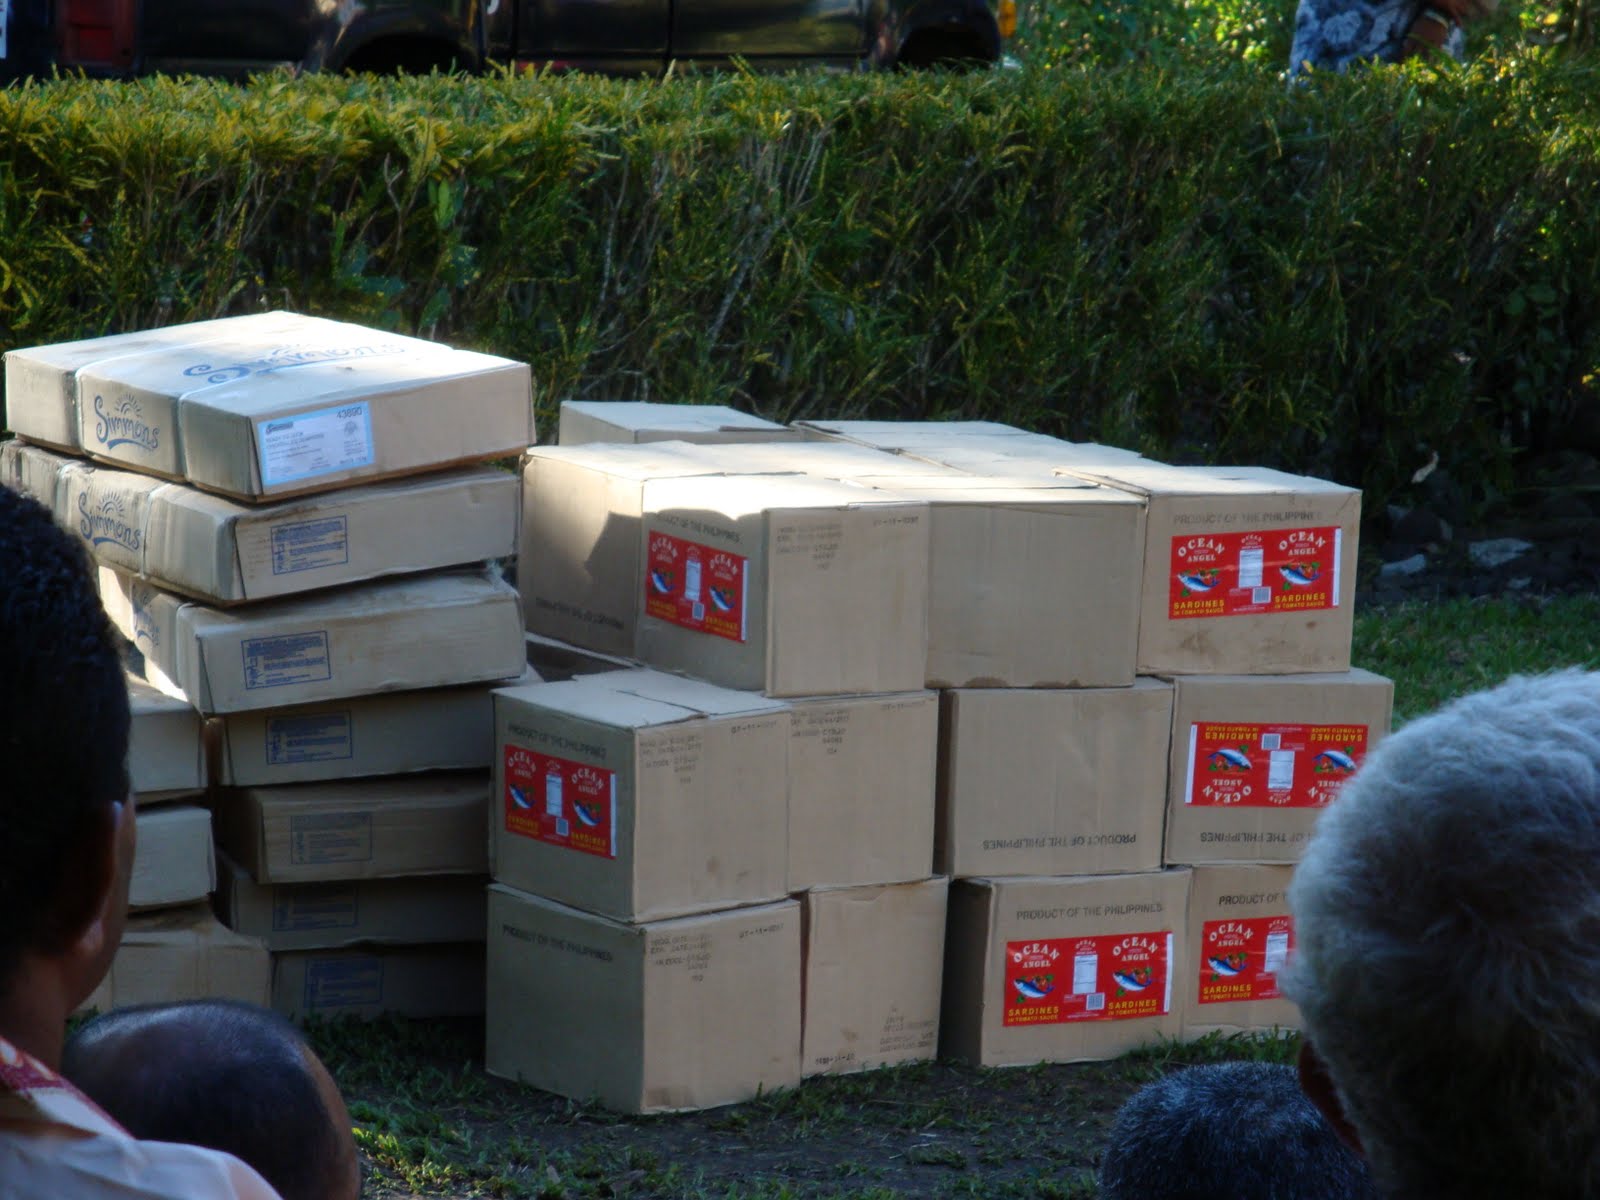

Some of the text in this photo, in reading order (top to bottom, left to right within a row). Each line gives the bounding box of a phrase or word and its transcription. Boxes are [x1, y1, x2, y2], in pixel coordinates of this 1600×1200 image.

[94, 395, 160, 449] Simmons
[78, 492, 142, 550] Simmons
[1174, 513, 1221, 525] PRODUCT
[1279, 531, 1326, 550] OCEAN
[1178, 538, 1225, 557] OCEAN
[1288, 547, 1317, 556] ANGEL
[1187, 554, 1217, 562] ANGEL
[1274, 592, 1326, 603] SARDINES
[1173, 599, 1225, 610] SARDINES
[1205, 731, 1258, 740] SARDINES
[1310, 733, 1362, 742] SARDINES
[571, 768, 604, 790] OCEAN
[1203, 786, 1252, 803] OCEAN
[1308, 787, 1338, 804] EAN
[1088, 833, 1137, 845] PRODUCT
[1200, 832, 1265, 843] PHILIPPINES
[1266, 832, 1286, 843] THE
[983, 837, 1046, 851] PHILIPPINES
[1218, 894, 1264, 906] PRODUCT
[1016, 903, 1163, 920] PRODUCT OF THE PHILIPPINES
[1209, 922, 1253, 942] OCEAN
[1112, 937, 1158, 956] OCEAN
[1217, 939, 1245, 947] ANGEL
[1013, 944, 1060, 963] OCEAN
[1121, 953, 1150, 962] ANGEL
[1022, 960, 1051, 969] ANGEL
[1203, 984, 1252, 995] SARDINES
[1108, 999, 1157, 1010] SARDINES
[1008, 1006, 1059, 1016] SARDINES
